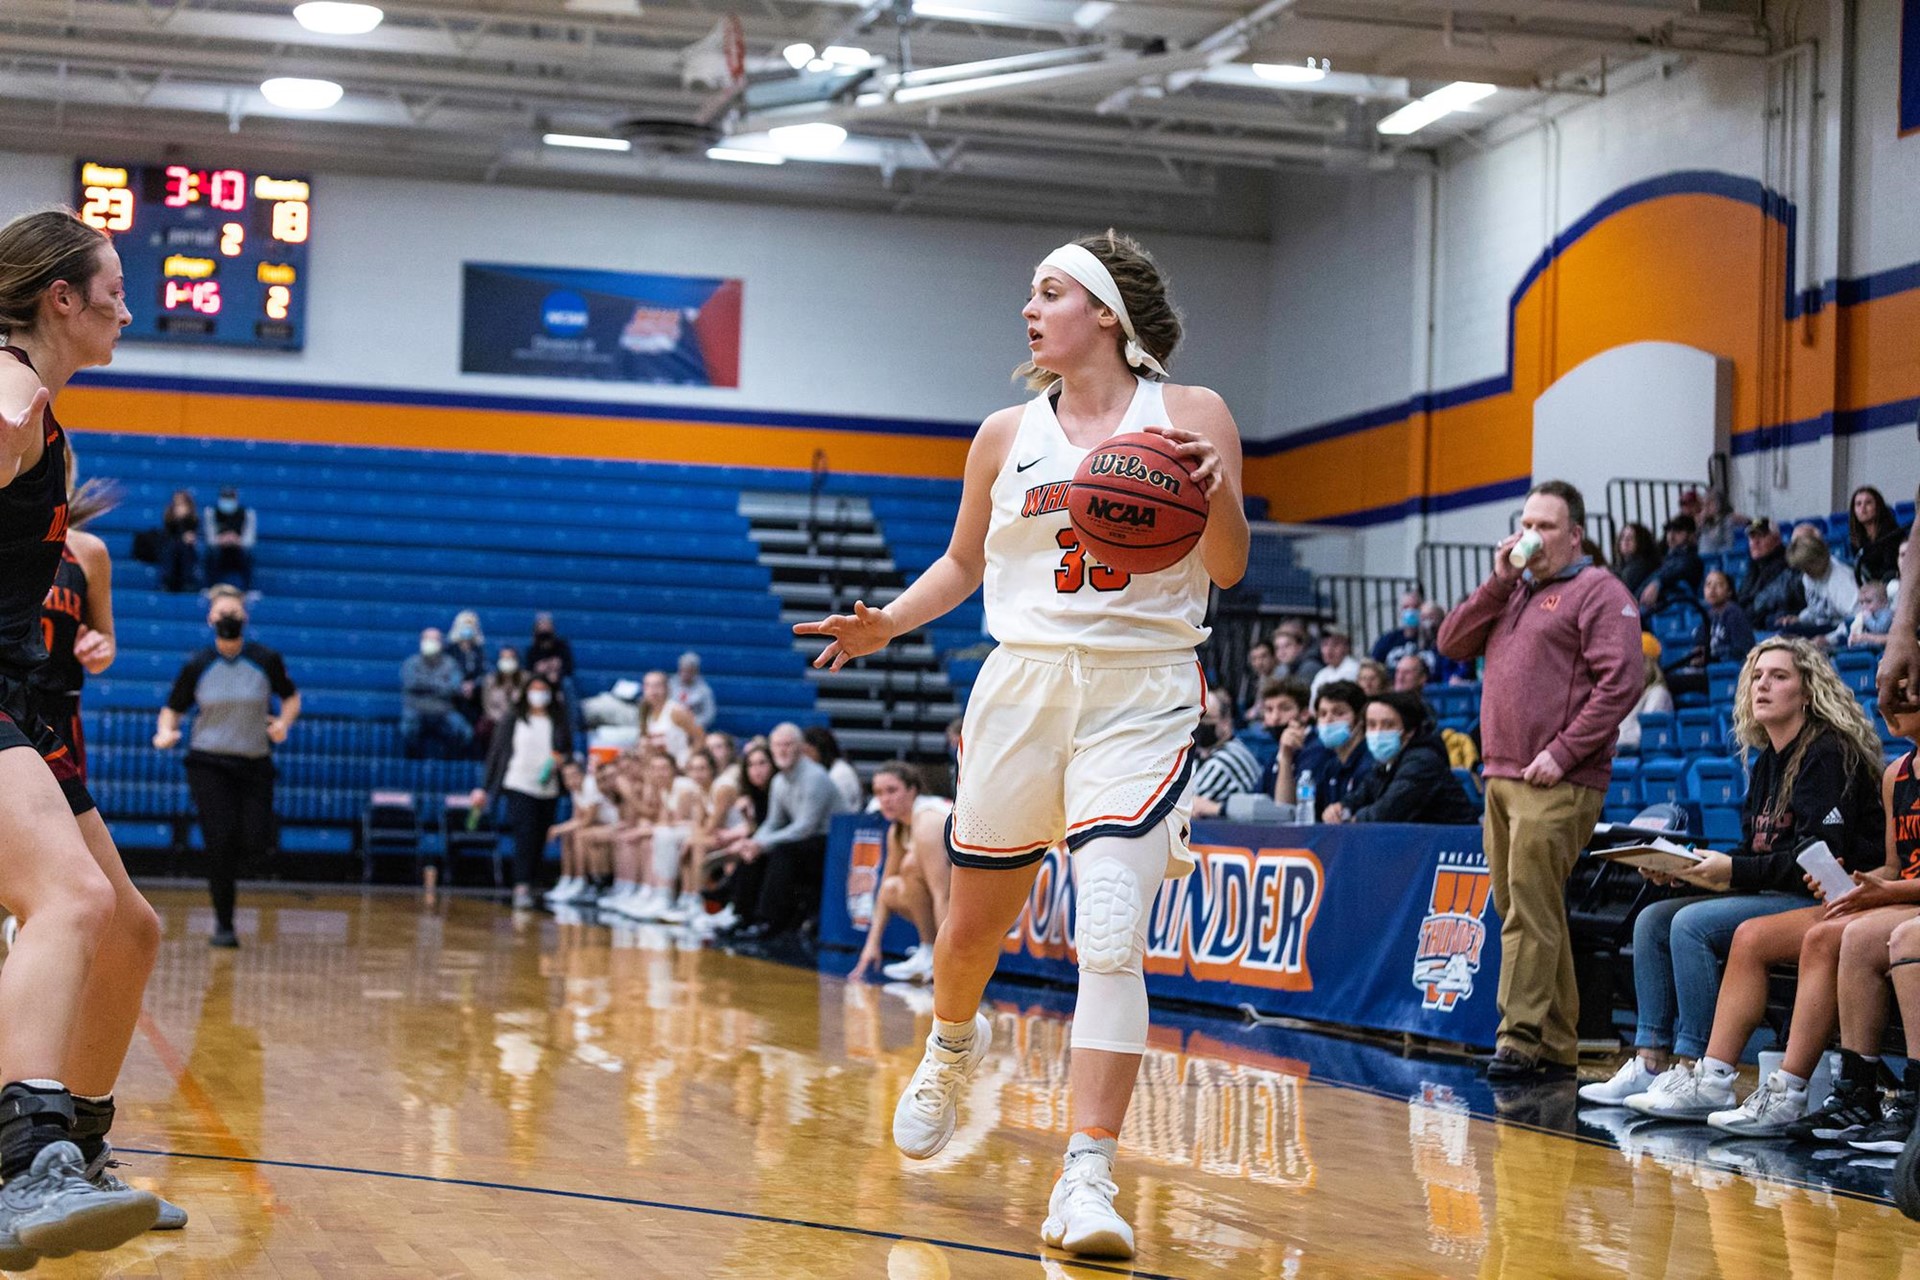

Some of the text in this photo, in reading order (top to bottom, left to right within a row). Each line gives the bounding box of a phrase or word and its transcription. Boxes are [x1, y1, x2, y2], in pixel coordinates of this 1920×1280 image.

[82, 187, 133, 231] 23
[1089, 453, 1182, 498] Wilson
[1086, 495, 1156, 528] NCAA
[1145, 850, 1318, 973] UNDER
